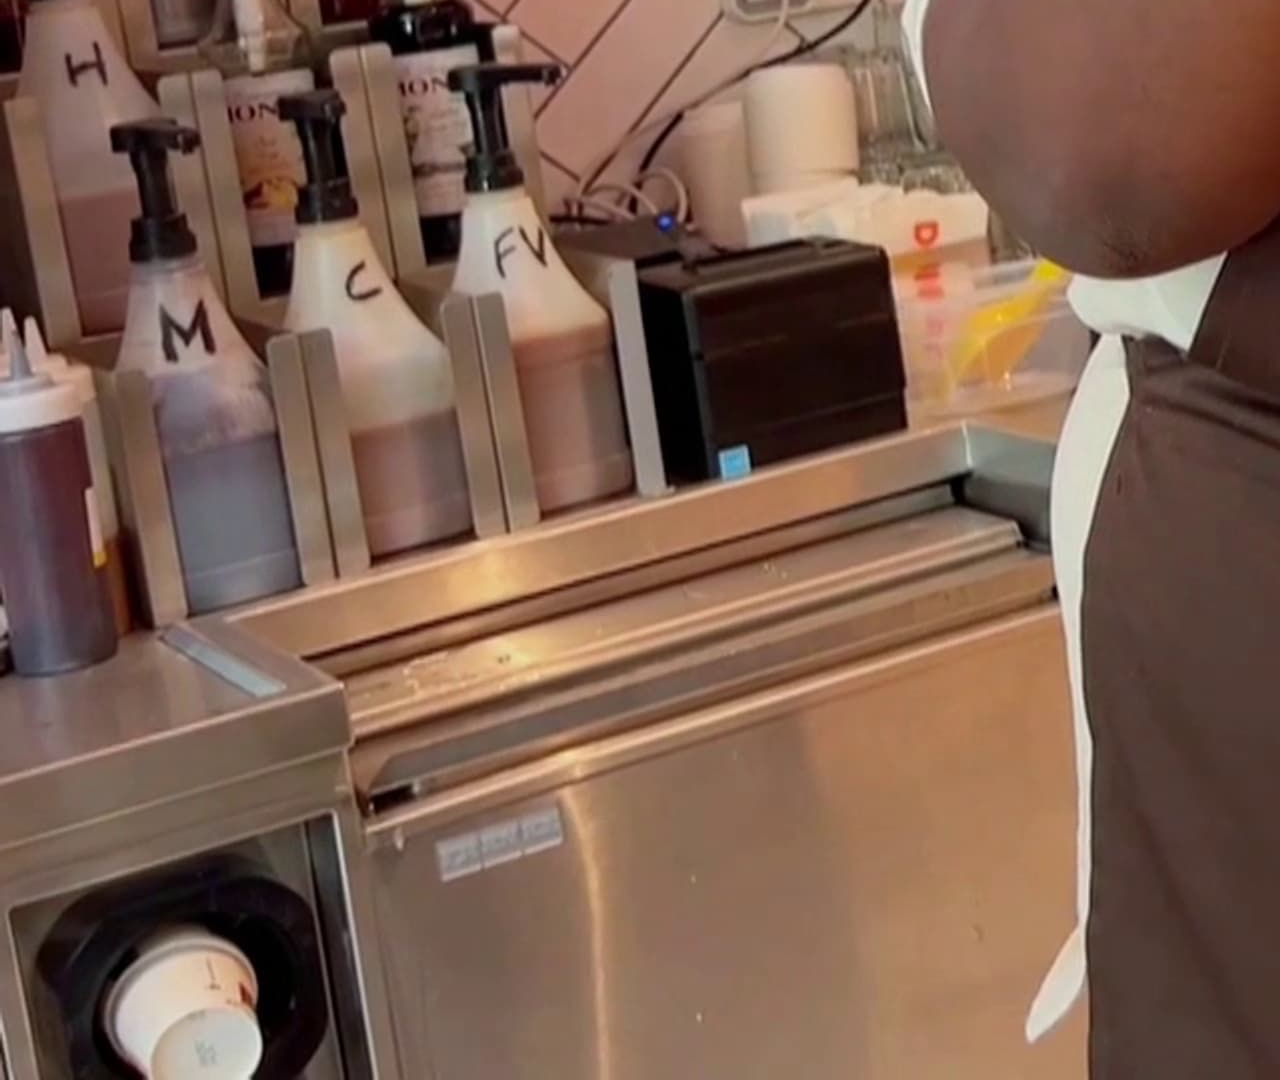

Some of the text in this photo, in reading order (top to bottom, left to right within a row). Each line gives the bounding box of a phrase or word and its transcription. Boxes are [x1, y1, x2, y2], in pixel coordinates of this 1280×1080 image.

[65, 41, 108, 87] H
[493, 227, 548, 278] FV
[345, 262, 382, 301] C
[160, 299, 216, 362] M
